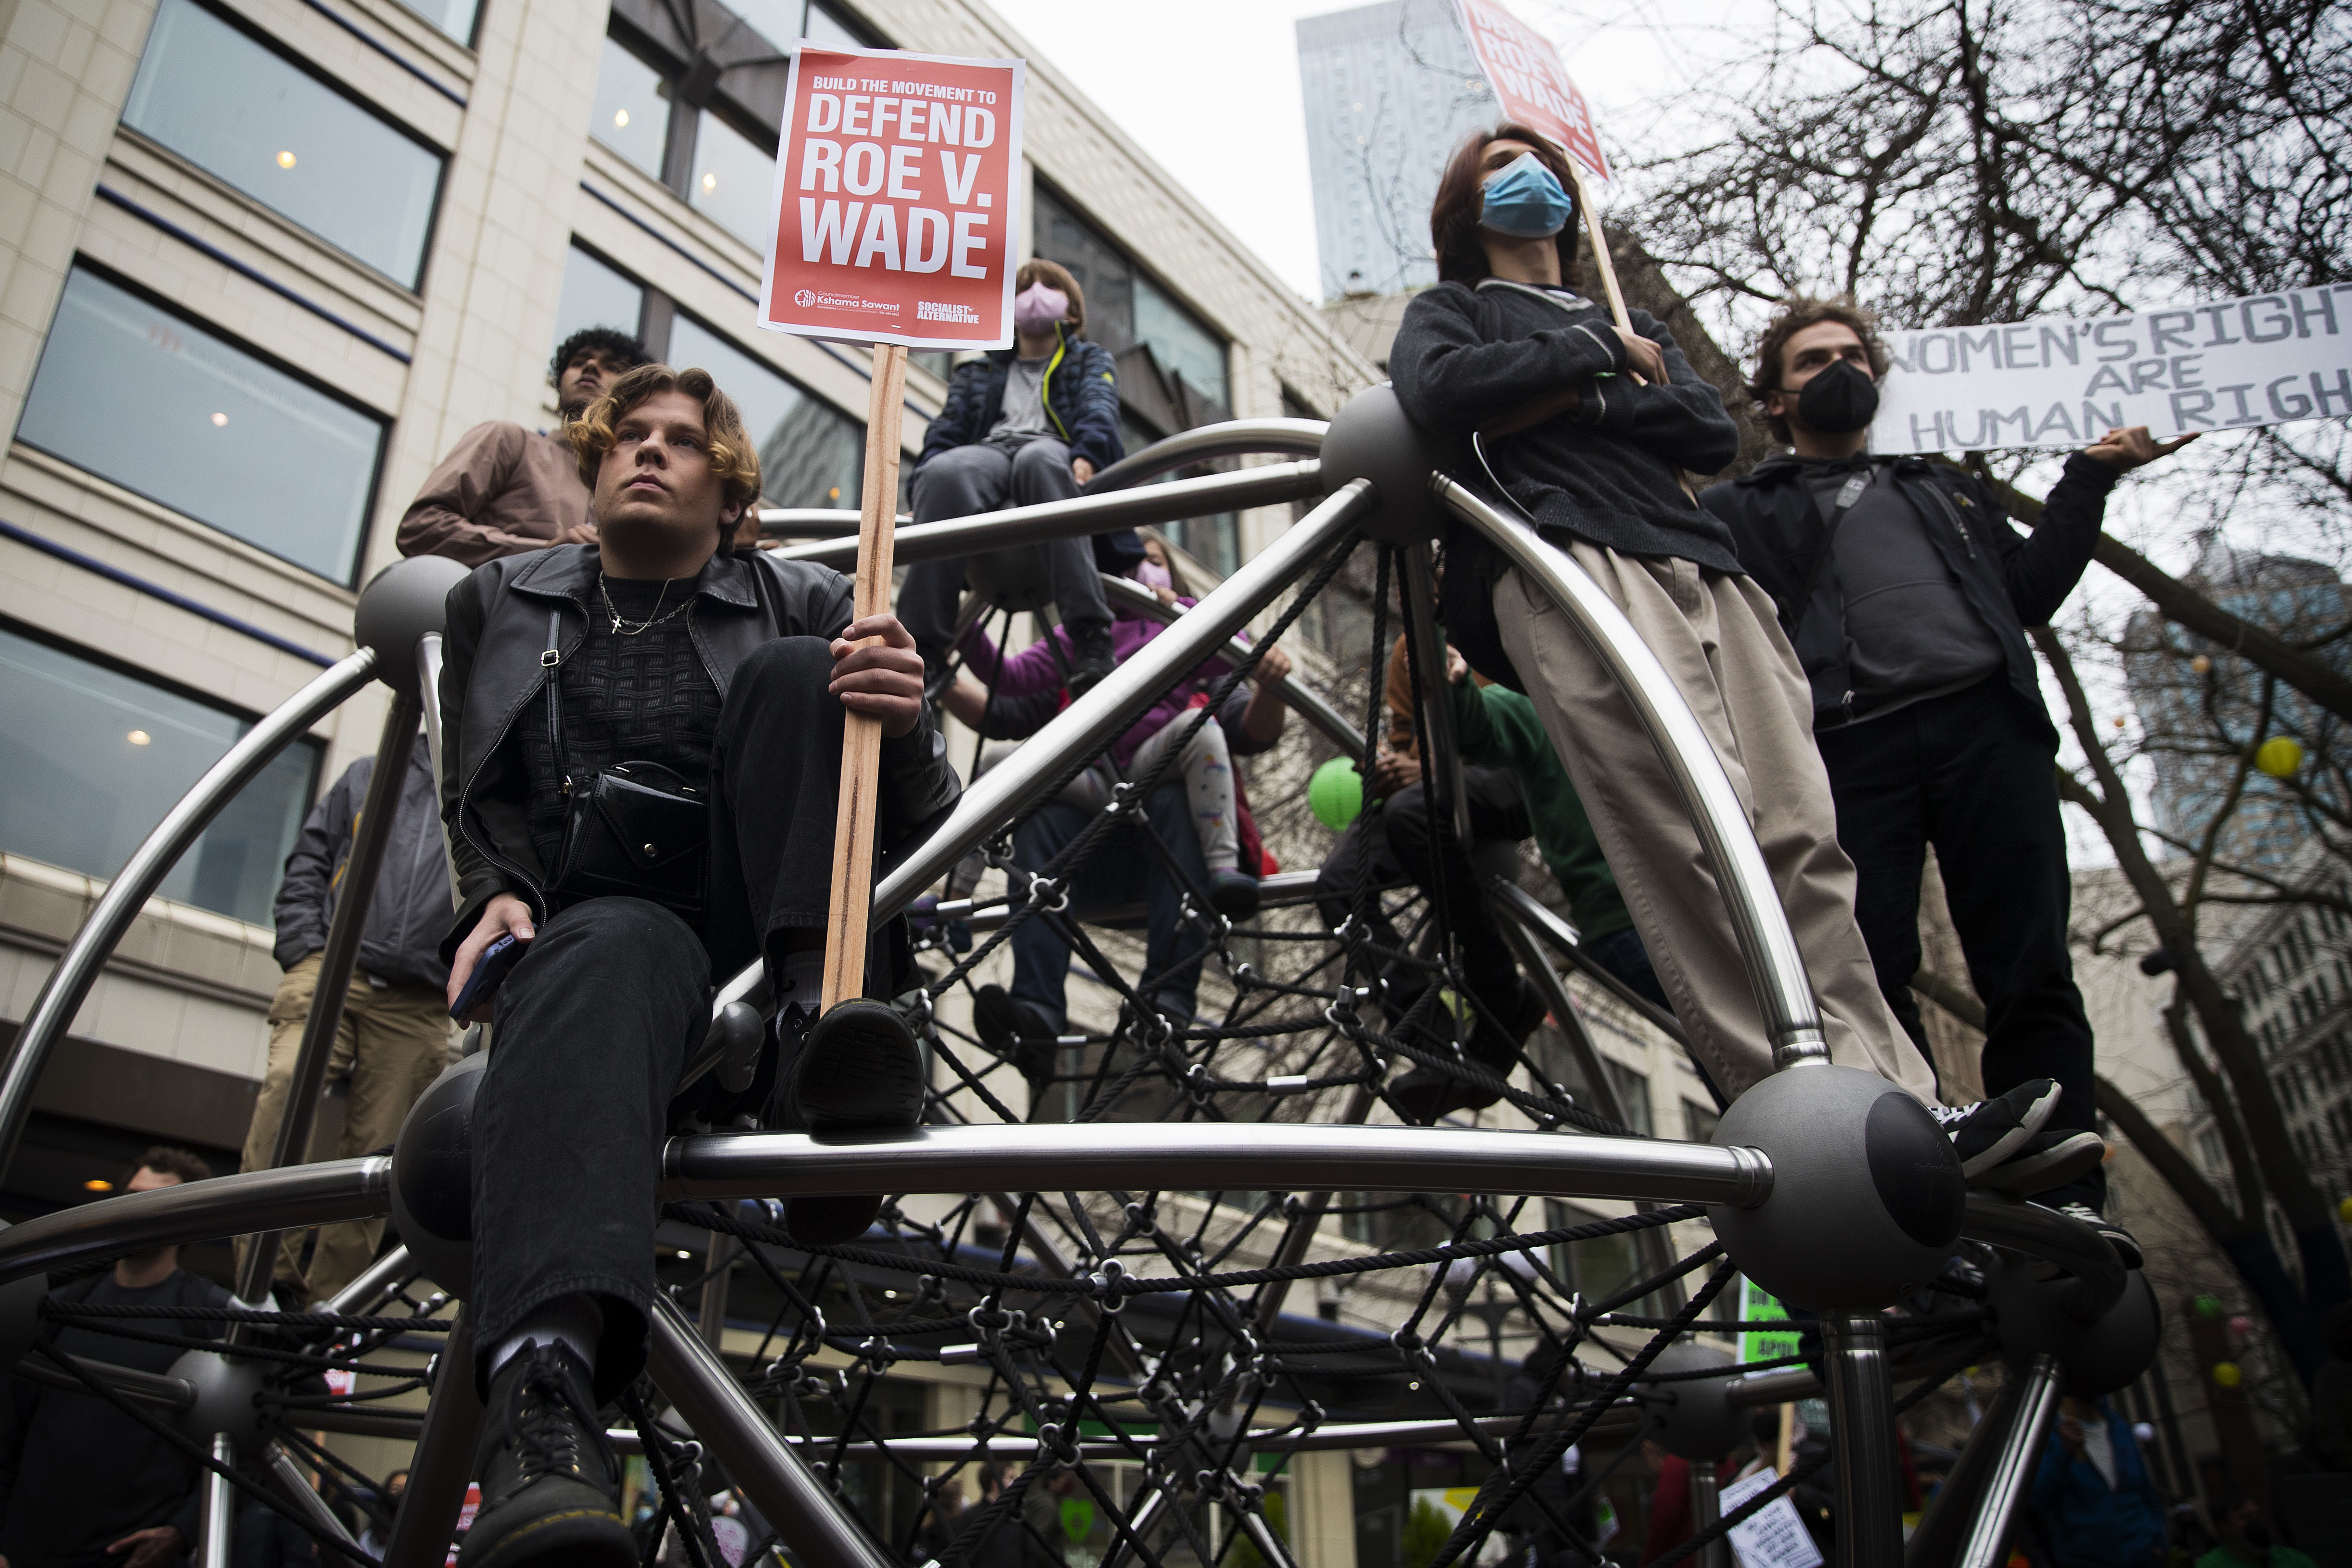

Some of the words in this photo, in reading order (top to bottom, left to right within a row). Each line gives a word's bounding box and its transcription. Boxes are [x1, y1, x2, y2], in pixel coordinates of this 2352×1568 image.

[1478, 28, 1551, 86] ROE
[813, 75, 857, 91] BUILD
[861, 78, 888, 93] THE
[891, 80, 975, 102] MOVEMENT
[977, 90, 996, 105] TO
[1491, 61, 1594, 144] WADE
[806, 93, 996, 149] DEFEND
[800, 138, 923, 200] ROE
[940, 150, 992, 208] V.
[799, 197, 989, 279] WADE
[817, 296, 859, 307] Kshama
[862, 300, 900, 312] Sawant
[818, 291, 860, 300] Councilmember
[916, 310, 979, 324] ALTERNATIVE
[917, 301, 969, 314] SOCIALIST
[2084, 352, 2204, 397] ARE
[1909, 400, 2124, 451] HUMAN
